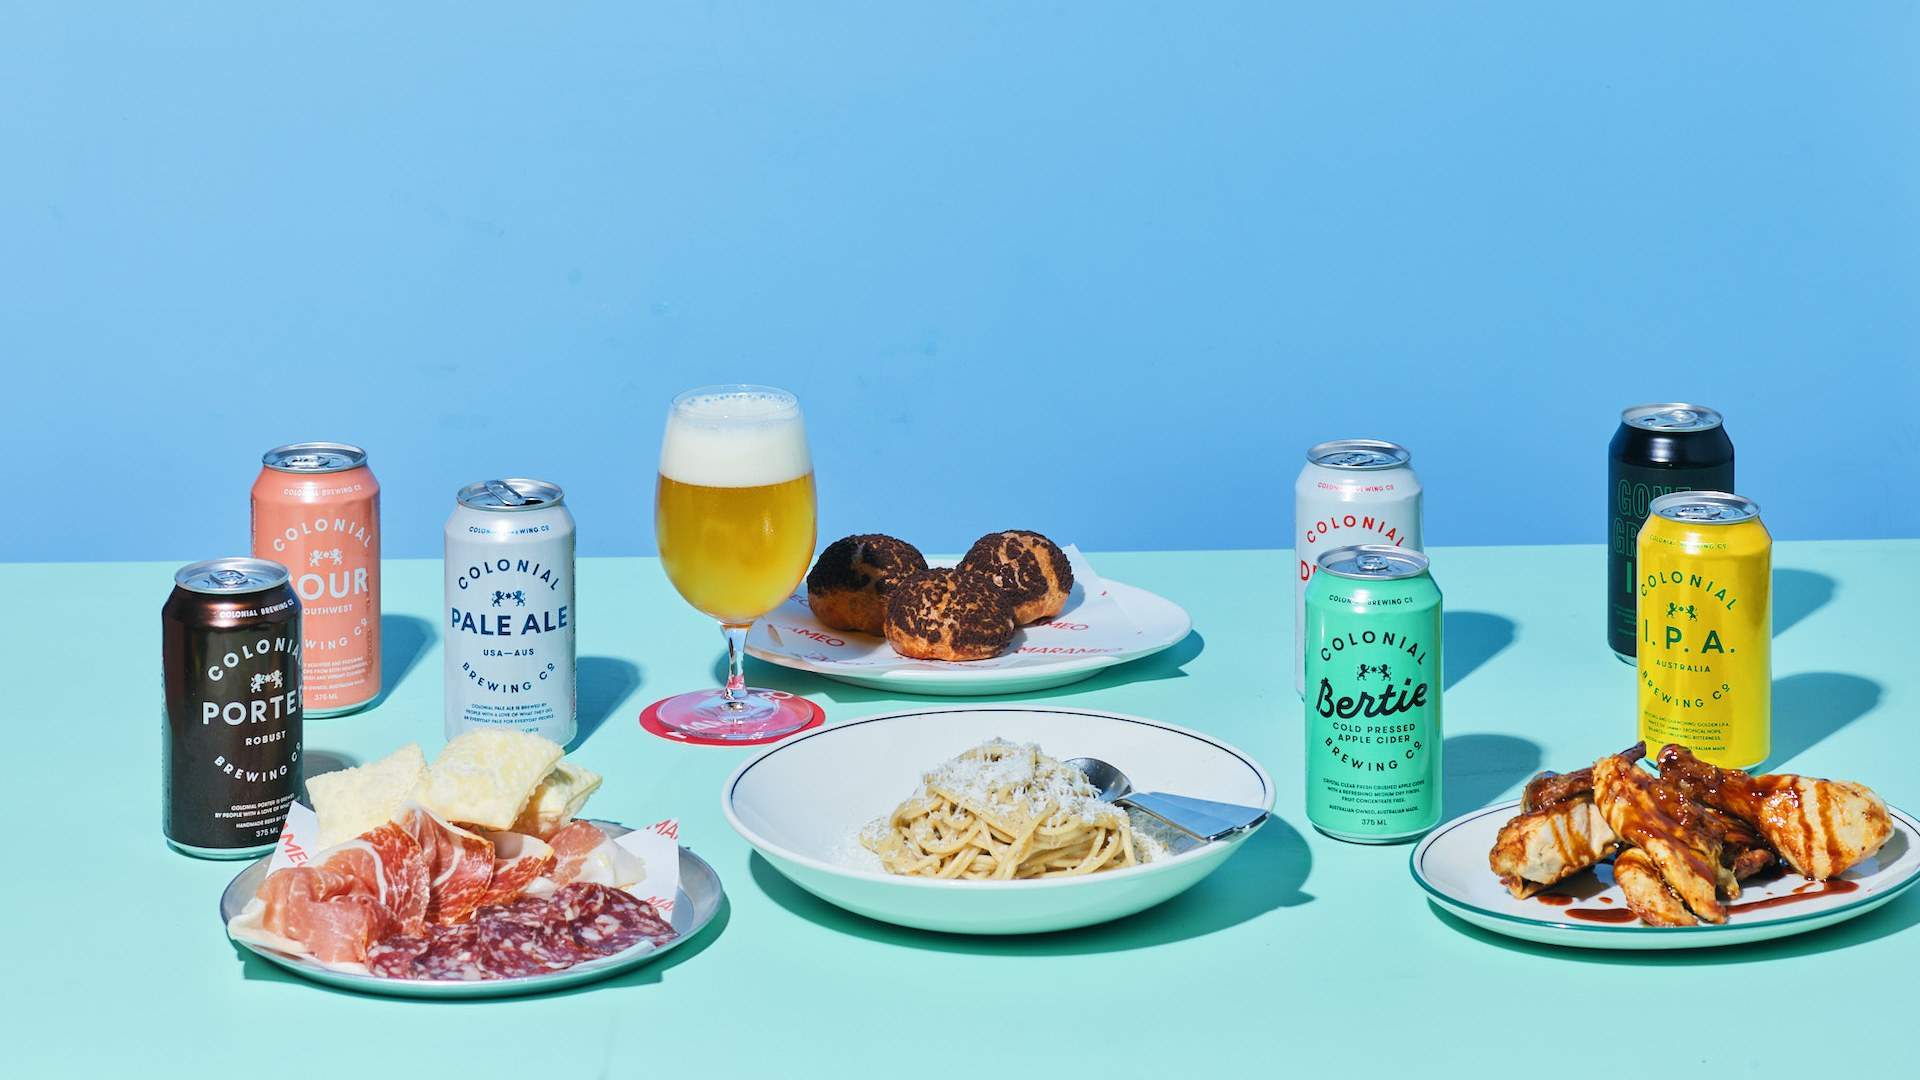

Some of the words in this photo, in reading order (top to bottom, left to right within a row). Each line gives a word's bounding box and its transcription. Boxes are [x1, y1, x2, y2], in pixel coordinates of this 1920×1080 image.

[273, 518, 371, 551] COLONIAL
[1307, 515, 1404, 547] COLONIAL
[290, 568, 369, 600] OUR
[459, 559, 559, 591] COLONIAL
[1641, 571, 1736, 610] COLONIAL
[219, 610, 258, 619] COLONIAL
[261, 602, 288, 616] BREWING
[303, 604, 353, 616] OUTHWEST
[451, 607, 512, 636] PALE
[521, 605, 568, 635] ALE
[304, 637, 348, 650] WING
[1321, 630, 1426, 665] COLONIAL
[463, 662, 531, 693] BREWING
[1656, 660, 1711, 673] AUSTRALIA
[1316, 677, 1428, 719] Bertie
[1642, 670, 1704, 708] BREWING
[202, 688, 301, 725] PORTE
[245, 730, 287, 746] ROBUST
[1332, 722, 1361, 733] COLD
[1367, 723, 1415, 734] PRESSED
[1338, 734, 1371, 744] APPLE
[1376, 734, 1410, 744] CIDER
[214, 755, 288, 783] BREWING
[1325, 737, 1398, 771] BREWING
[222, 811, 243, 819] PEOPLE
[255, 829, 269, 838] 375
